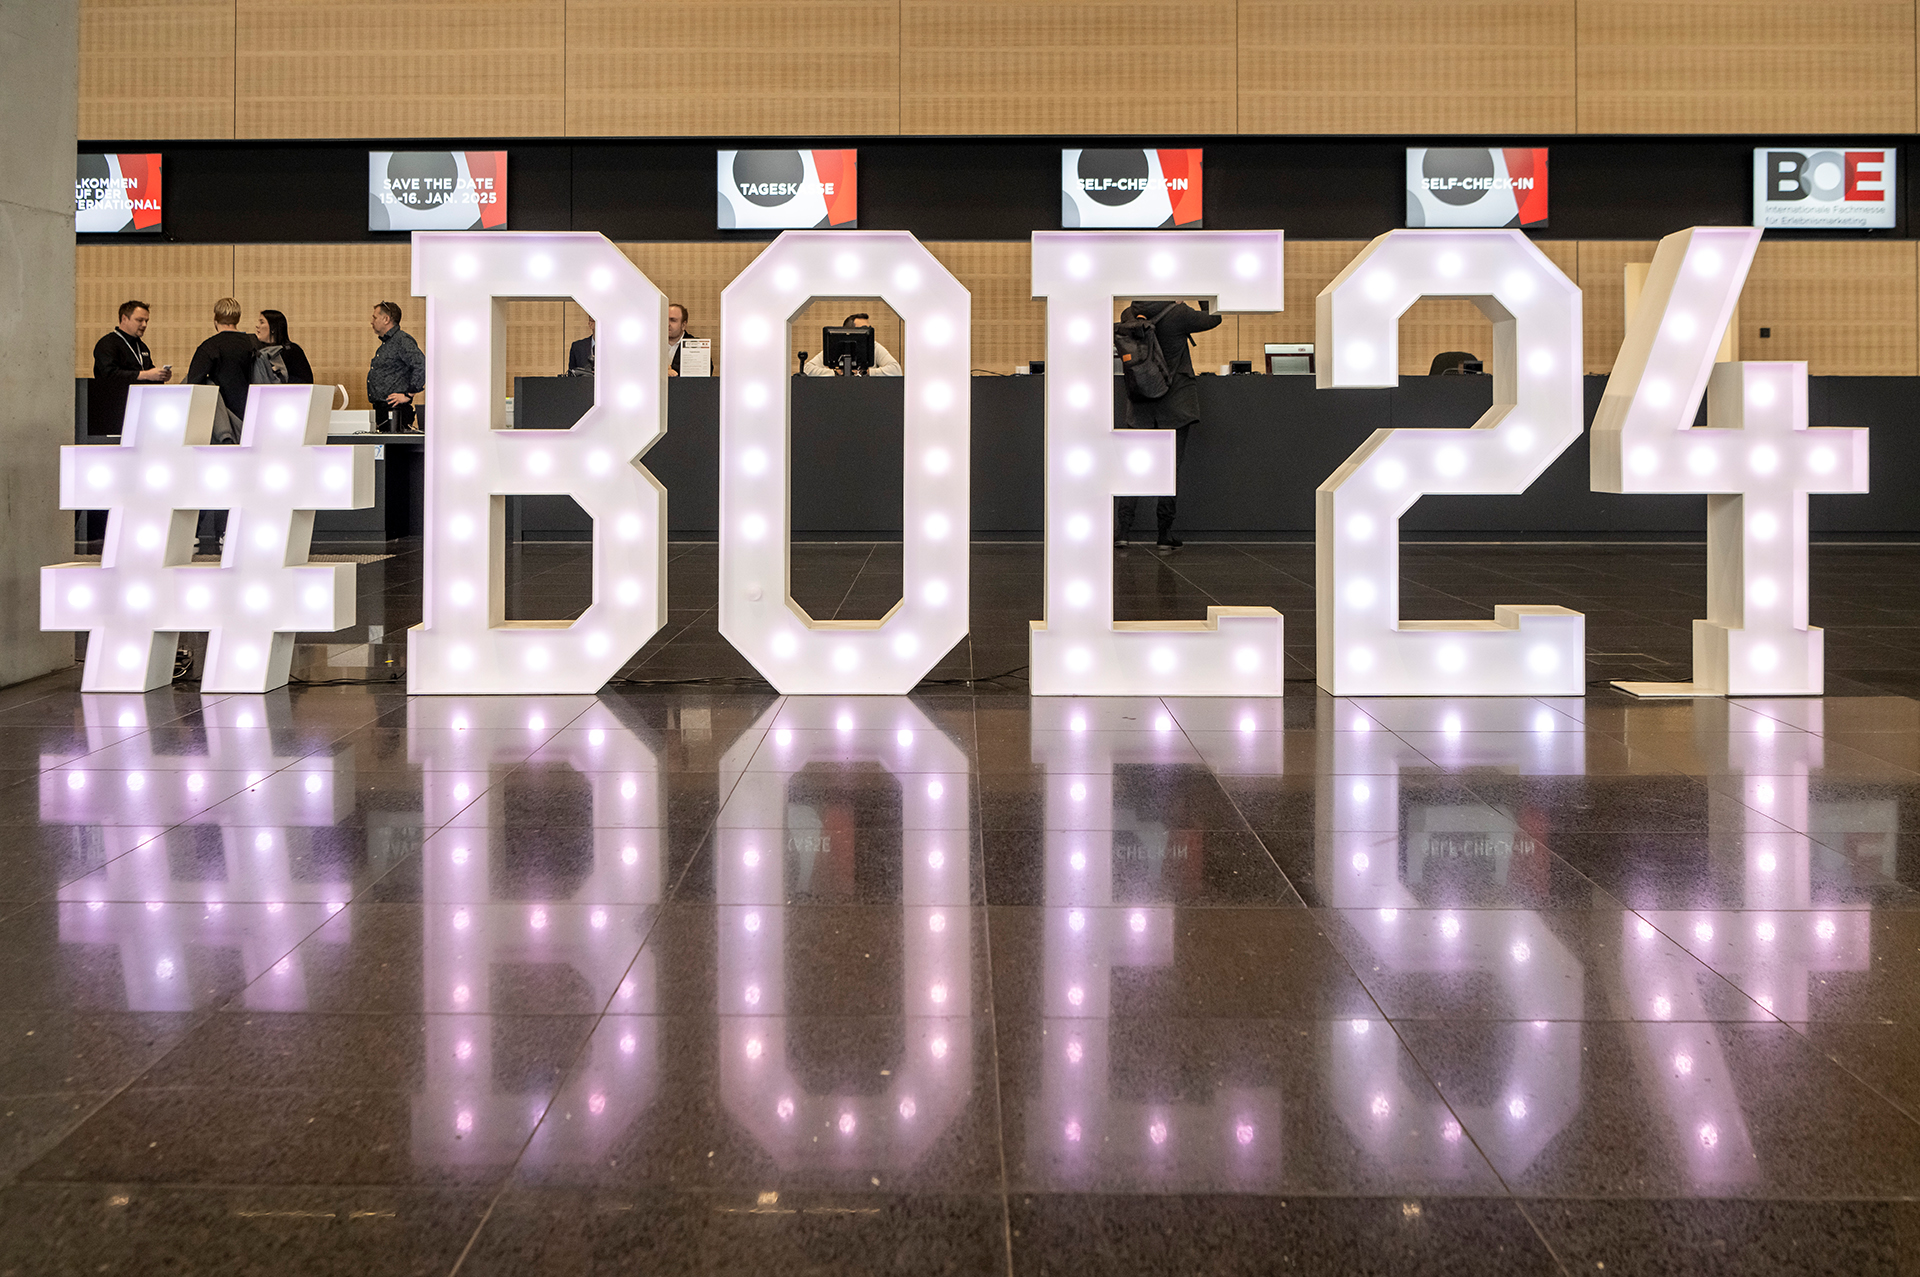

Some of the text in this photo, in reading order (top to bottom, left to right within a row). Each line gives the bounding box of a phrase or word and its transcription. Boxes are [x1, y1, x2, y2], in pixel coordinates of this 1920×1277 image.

[1766, 151, 1885, 202] BOE
[383, 178, 494, 190] SAVE THE DATE
[740, 182, 835, 196] TAGESKASSE
[1076, 178, 1188, 191] SELF-CHECK-IN
[1421, 177, 1534, 190] SELF-CHECK-IN
[95, 189, 121, 200] DER
[379, 192, 497, 205] 15.-16. JAN. 2025
[1766, 205, 1886, 215] Internationale Fachmesse
[1766, 216, 1867, 227] für Erlebnismarketing
[40, 226, 1872, 698] #BOE24
